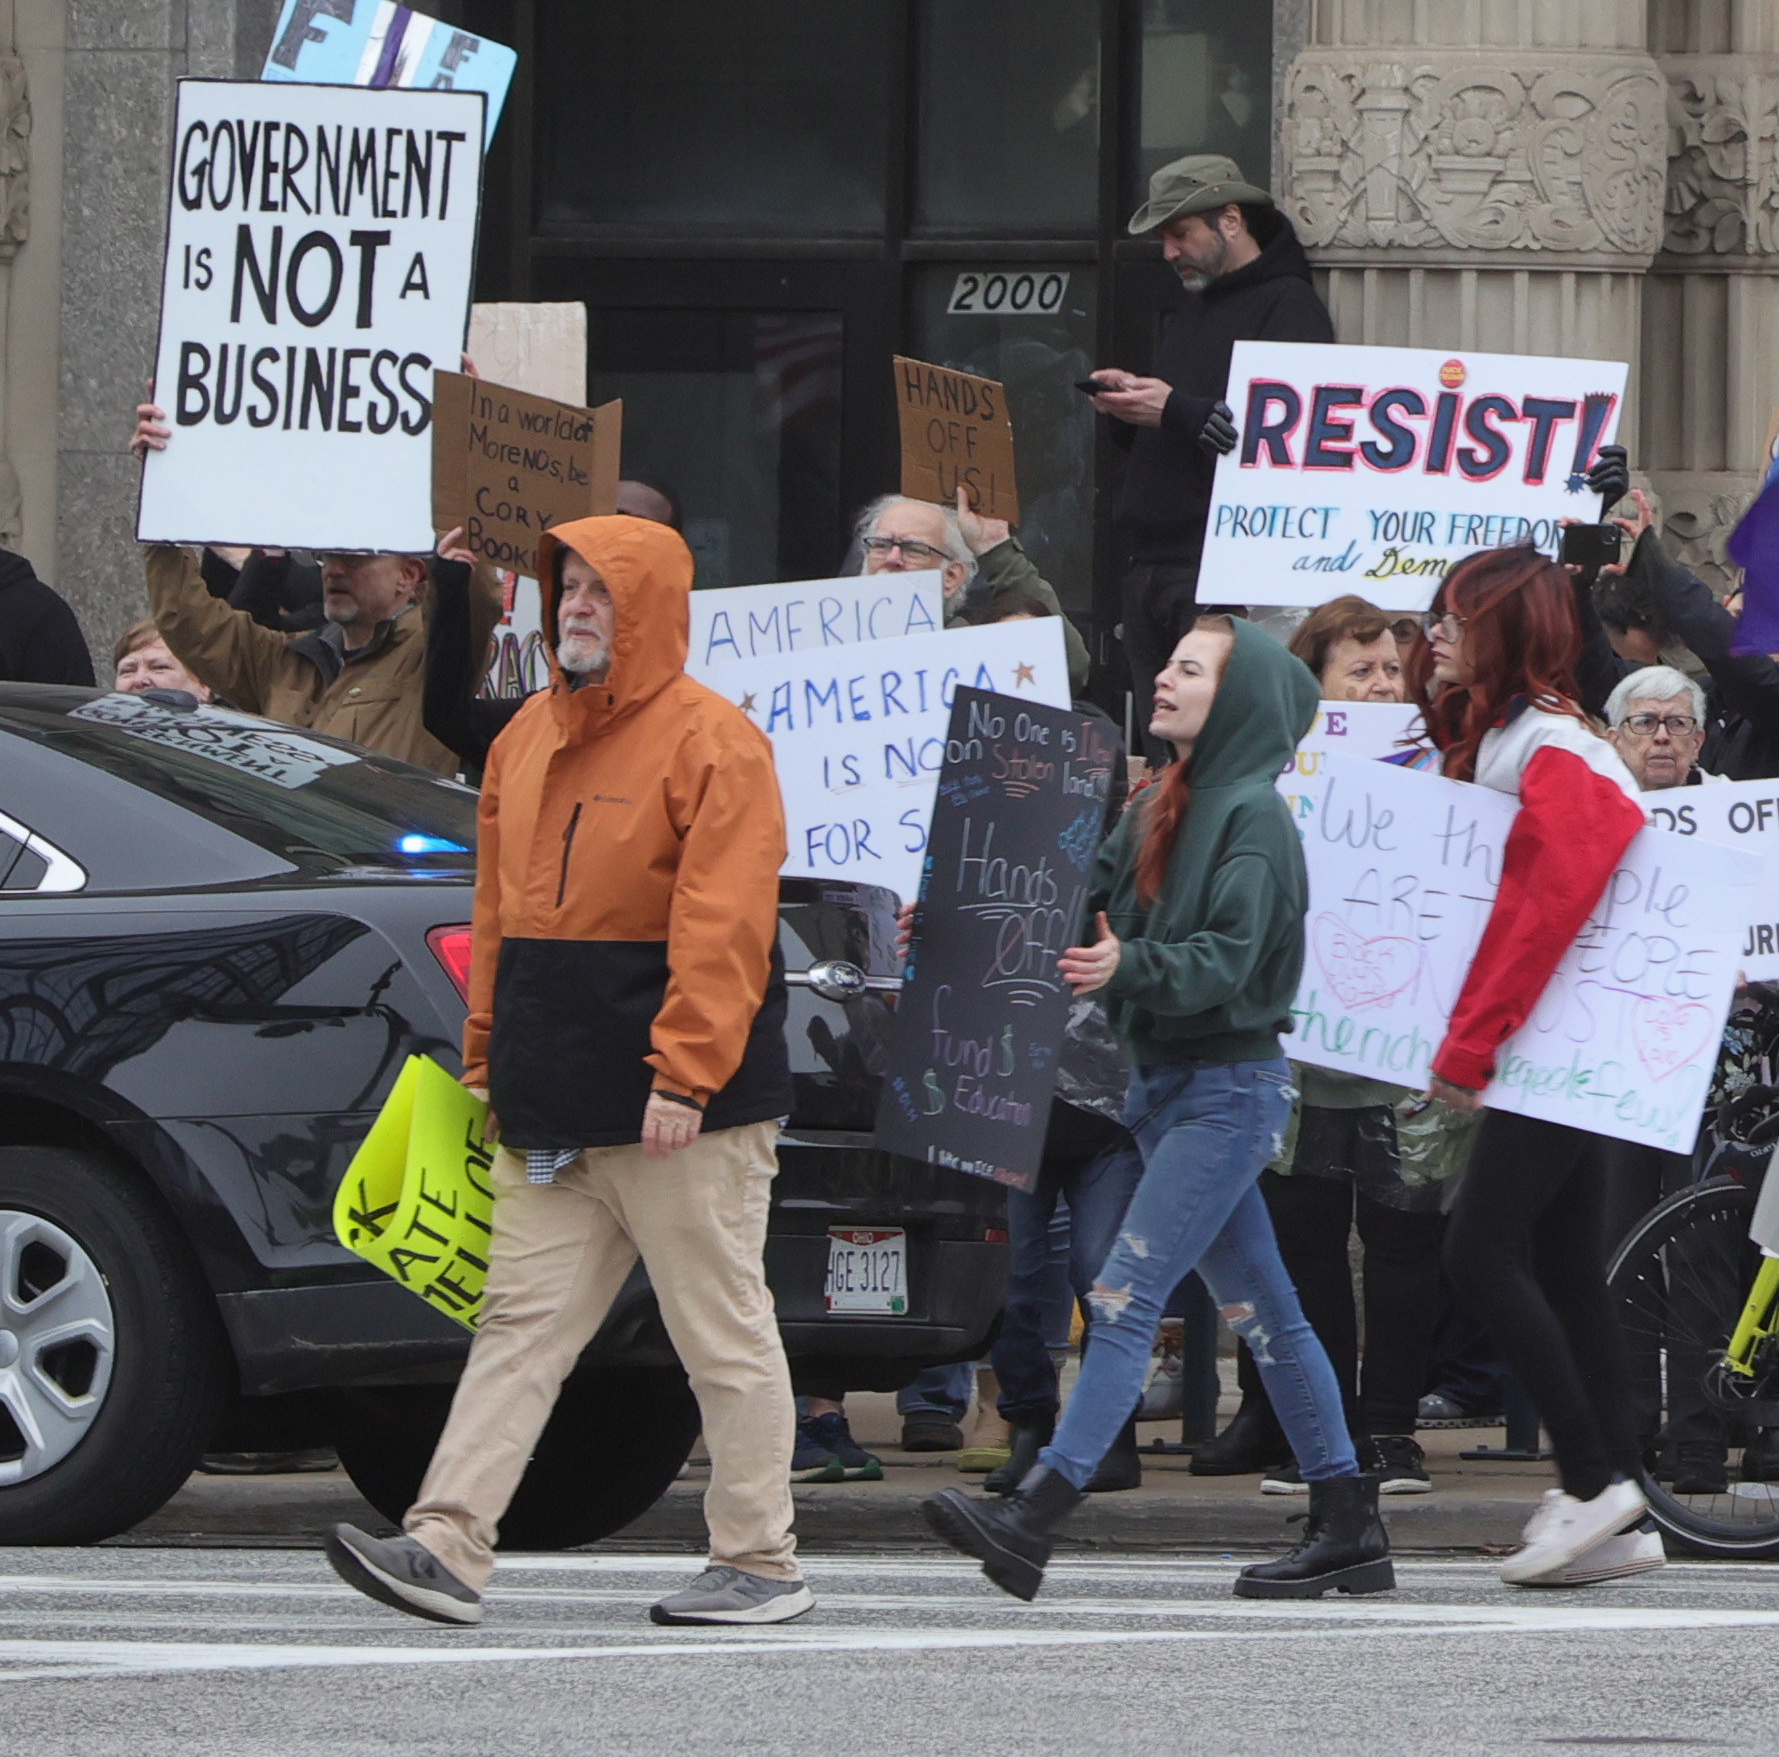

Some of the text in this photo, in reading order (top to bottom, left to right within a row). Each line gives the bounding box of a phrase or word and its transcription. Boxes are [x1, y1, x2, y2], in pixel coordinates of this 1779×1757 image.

[178, 118, 466, 221] GOVERNMENT
[183, 224, 430, 330] IS NOT A
[953, 274, 1063, 311] 2000
[175, 342, 434, 437] BUSINESS
[469, 380, 494, 419] In
[497, 404, 510, 423] a
[903, 362, 995, 421] HANDS
[927, 418, 978, 459] OFF
[1239, 377, 1620, 495] RESIST!
[507, 475, 520, 493] a
[568, 455, 590, 486] be
[475, 486, 553, 532] CORY
[1214, 505, 1340, 540] PROTECT
[1369, 509, 1437, 545] YOUR
[1292, 538, 1364, 572] and
[967, 700, 1005, 739] No
[1014, 713, 1049, 745] One
[1061, 730, 1077, 753] is
[823, 755, 862, 789] IS
[946, 739, 983, 763] on
[1319, 776, 1398, 851] We
[805, 818, 882, 869] FOR
[956, 816, 1059, 907] Hands
[931, 984, 994, 1078] fund
[860, 1250, 900, 1293] 3127
